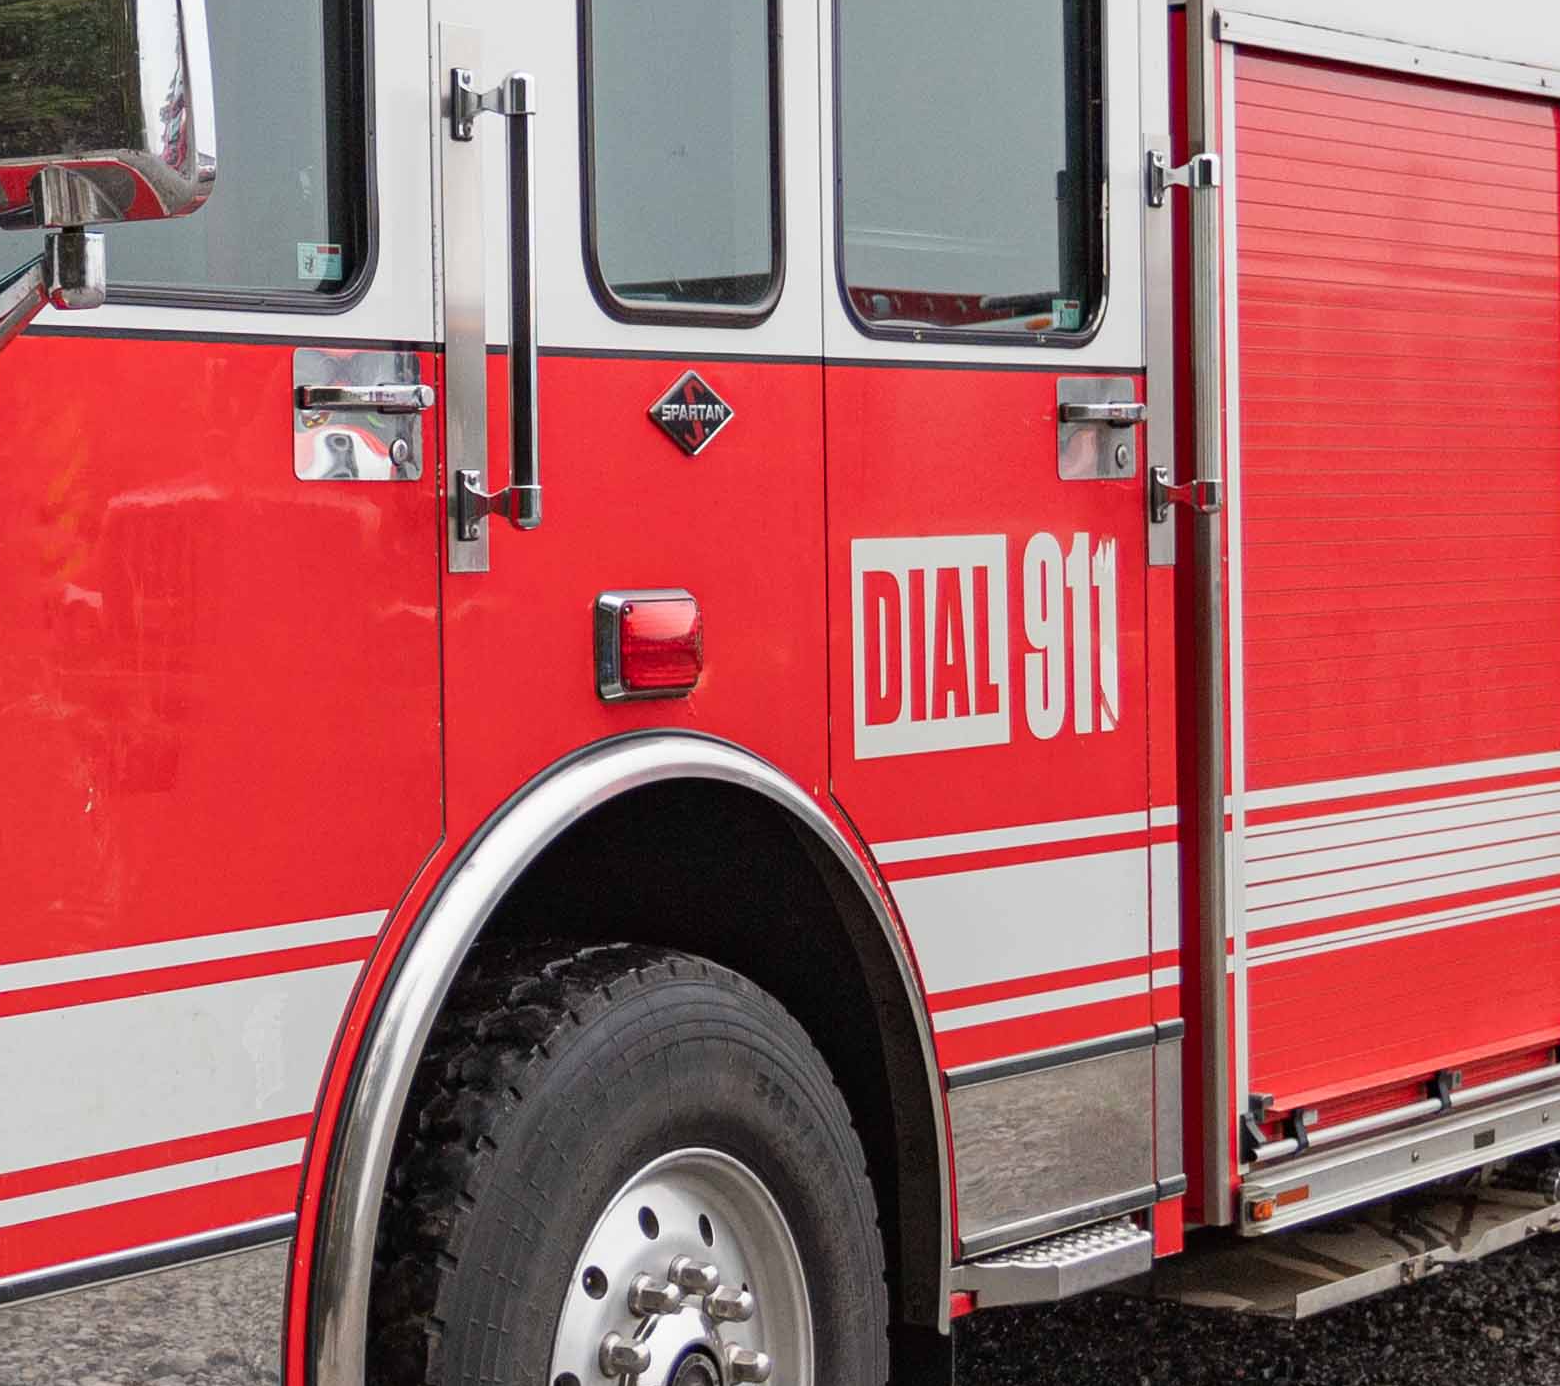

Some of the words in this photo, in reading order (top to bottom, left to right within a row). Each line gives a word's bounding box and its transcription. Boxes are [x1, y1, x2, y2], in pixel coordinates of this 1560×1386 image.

[661, 404, 725, 422] SPARTAN
[862, 564, 1000, 727] DIAL
[1022, 531, 1120, 741] 911
